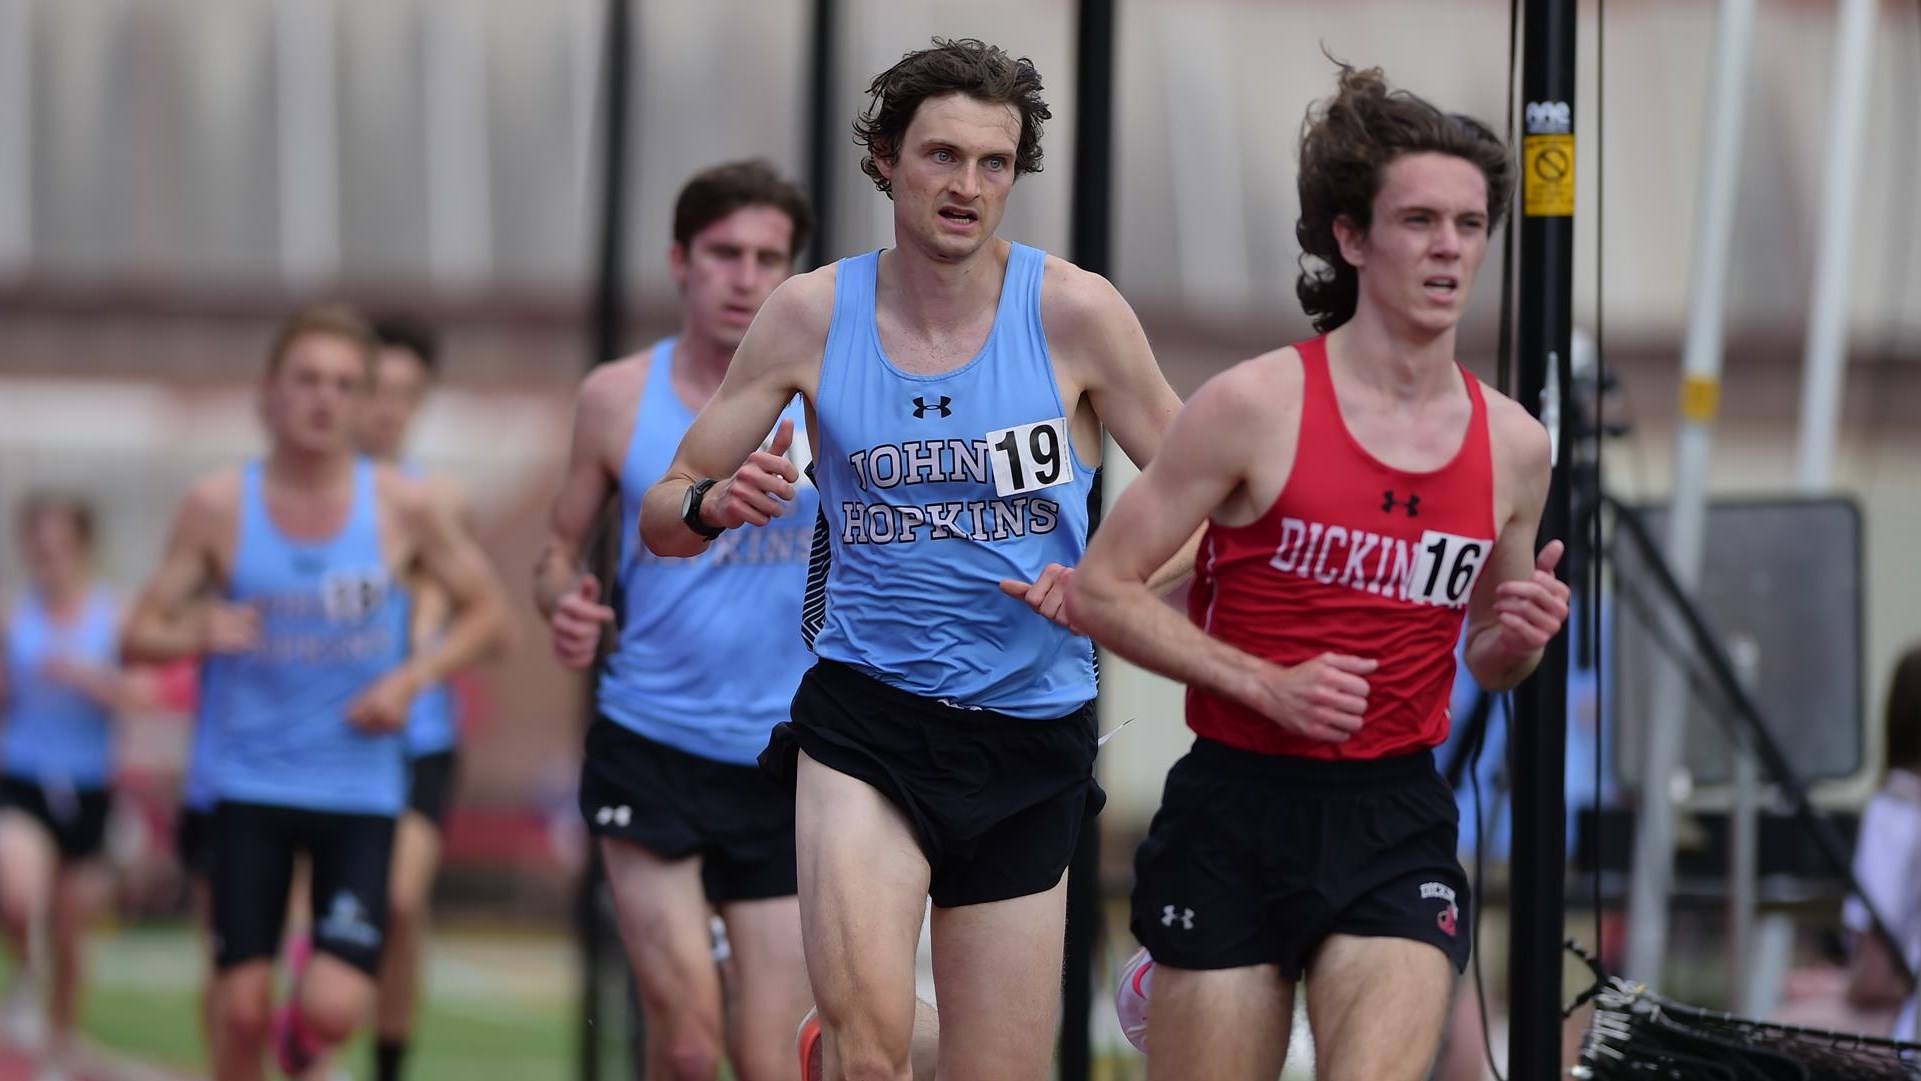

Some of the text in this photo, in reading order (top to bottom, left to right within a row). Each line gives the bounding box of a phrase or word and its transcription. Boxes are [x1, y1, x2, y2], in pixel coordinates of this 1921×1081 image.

[849, 438, 990, 492] JOHN
[994, 423, 1062, 492] 19
[842, 498, 1059, 544] HOPKINS
[1269, 516, 1424, 601] DICKIN
[1423, 537, 1481, 601] 16
